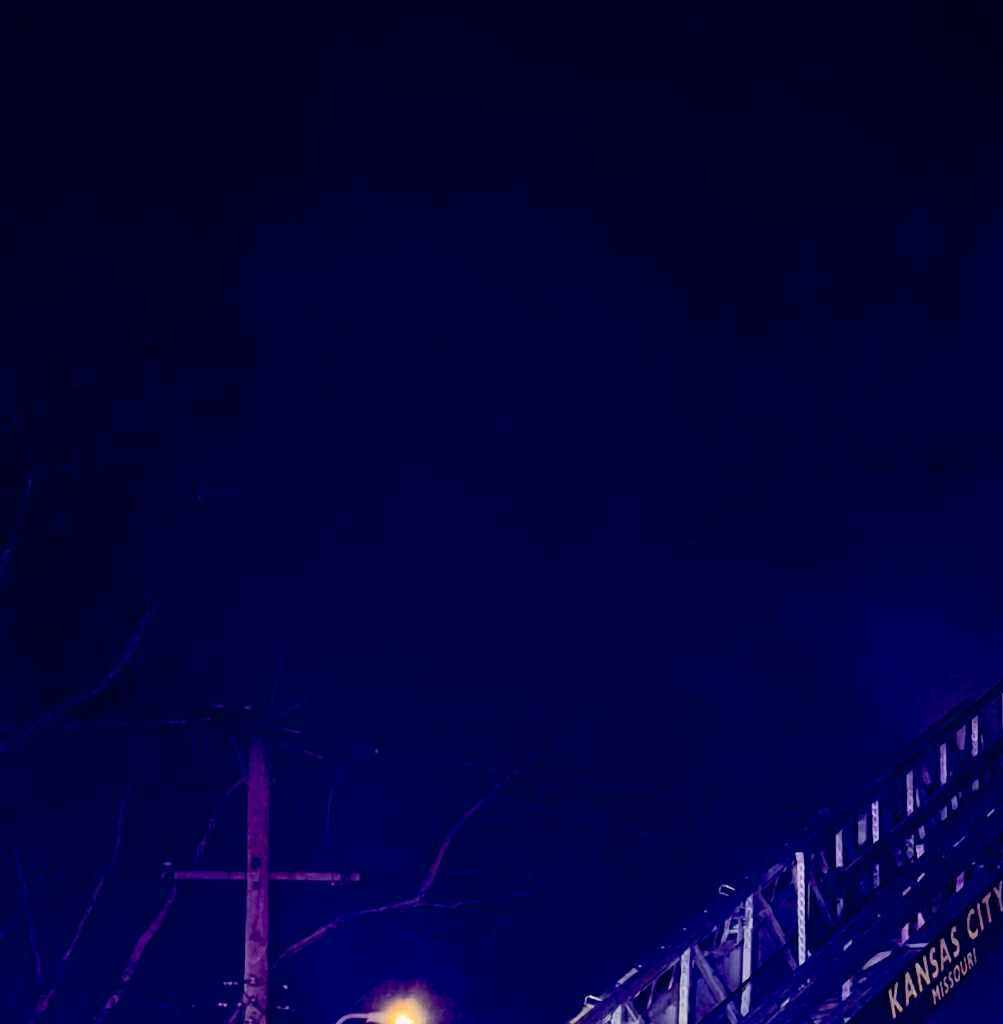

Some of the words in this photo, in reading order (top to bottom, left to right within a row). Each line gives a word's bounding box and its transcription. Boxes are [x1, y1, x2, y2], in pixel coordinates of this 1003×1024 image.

[888, 926, 960, 1019] KANSAS
[966, 880, 1003, 940] CITY
[931, 948, 977, 1005] MISSOURI
